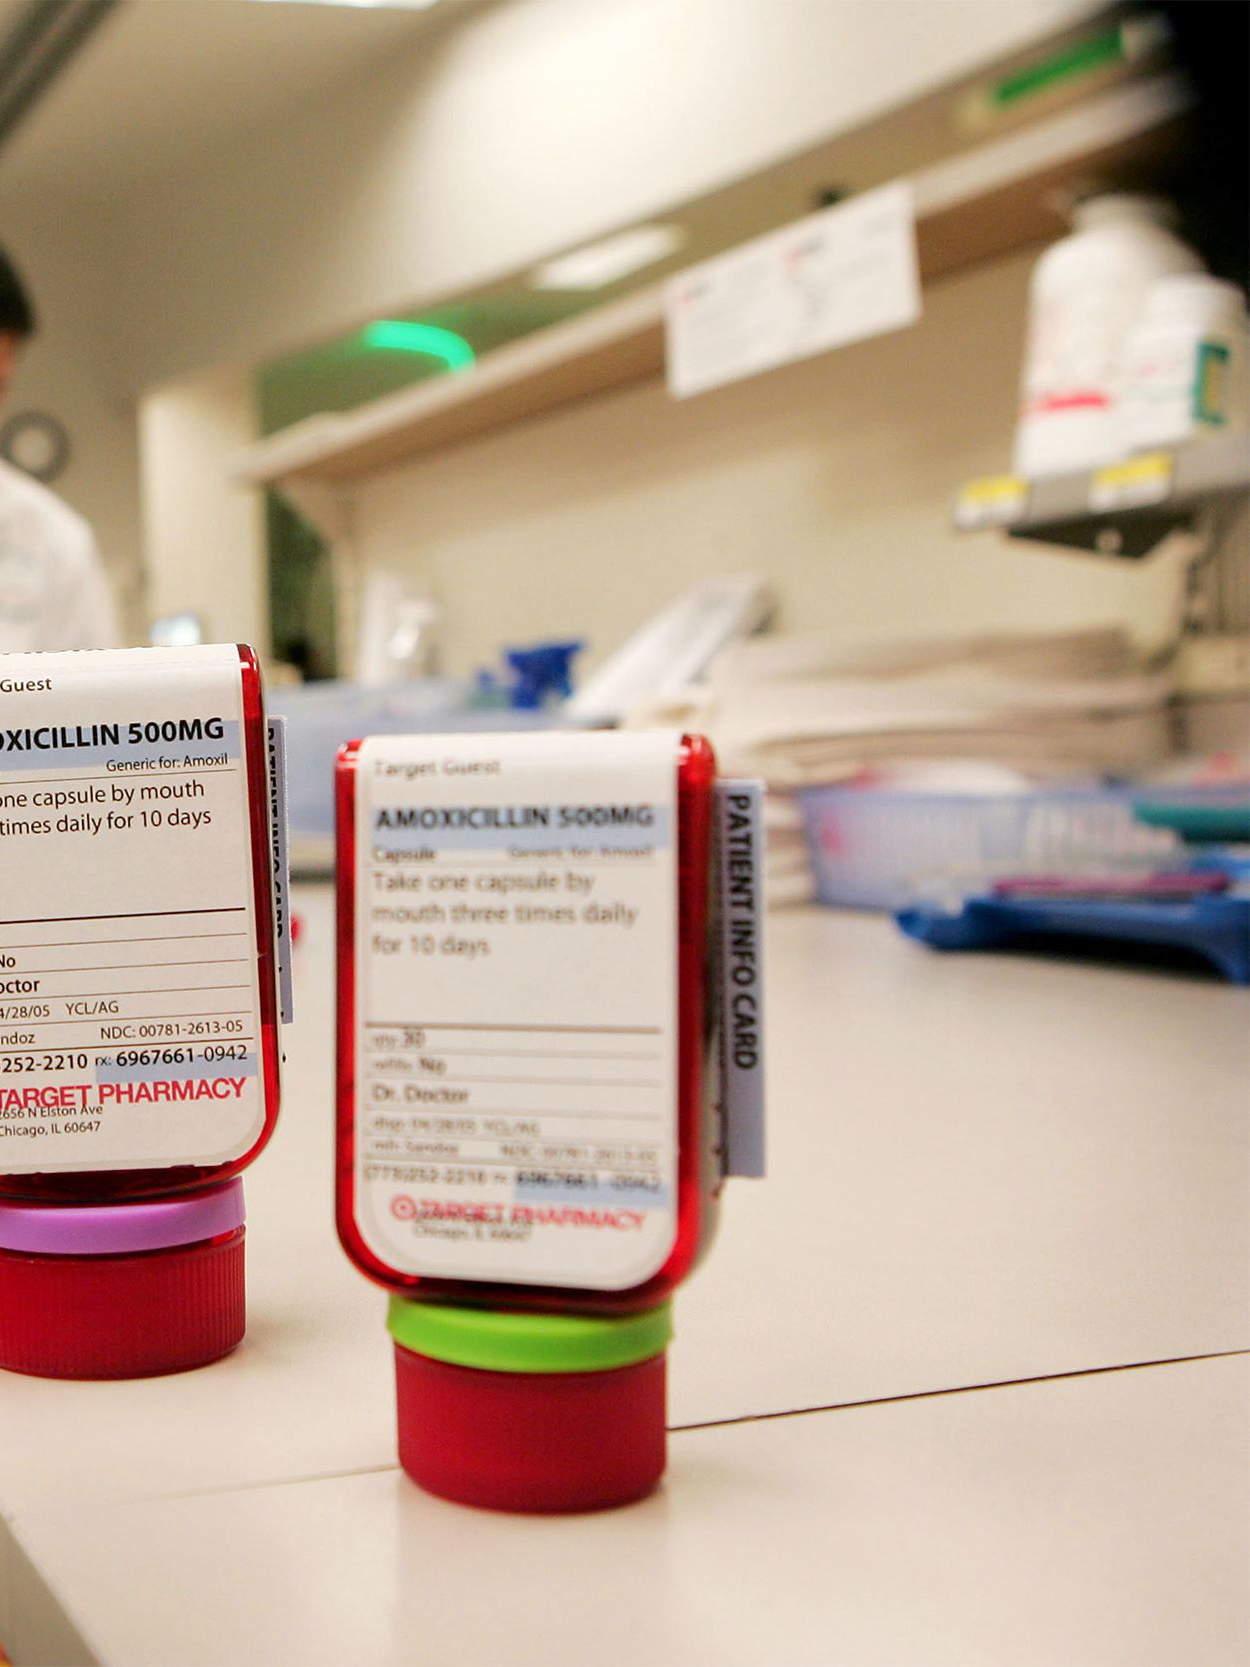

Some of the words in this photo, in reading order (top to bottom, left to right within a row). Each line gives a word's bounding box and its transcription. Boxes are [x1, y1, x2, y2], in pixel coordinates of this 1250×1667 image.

[0, 678, 52, 692] Guest
[128, 717, 224, 743] 500MG
[106, 757, 155, 772] Generic
[159, 756, 181, 768] for:
[183, 754, 228, 767] Amoxil
[375, 761, 436, 778] Target
[443, 760, 500, 774] Guest
[32, 786, 105, 810] capsule
[111, 784, 134, 805] by
[140, 780, 205, 799] mouth
[0, 819, 51, 835] times
[57, 814, 102, 838] daily
[107, 812, 133, 829] for
[141, 811, 162, 827] 10
[167, 808, 211, 830] days
[376, 808, 548, 830] AMOXICILLIN
[560, 805, 653, 826] 500MG
[728, 794, 754, 914] PATIENT
[375, 873, 420, 890] Take
[430, 874, 468, 891] one
[477, 872, 557, 895] capsule
[566, 871, 594, 895] by
[372, 904, 444, 922] mouth
[452, 902, 507, 923] three
[515, 904, 575, 923] times
[584, 902, 637, 926] daily
[372, 935, 402, 954] for
[411, 936, 433, 954] 10
[442, 936, 489, 959] days
[733, 924, 756, 988] INFO
[65, 1000, 119, 1016] YCL/AG
[100, 1026, 136, 1039] NDC:
[139, 1019, 243, 1038] 00781-2613-05
[735, 996, 757, 1071] CARD
[95, 1056, 112, 1065] rx:
[116, 1045, 248, 1067] 6967661-0942
[99, 1077, 247, 1104] PHARMACY
[406, 1086, 469, 1103] Doctor
[28, 1106, 37, 1117] N
[40, 1104, 77, 1117] Elston
[80, 1103, 103, 1115] Ave
[51, 1123, 61, 1134] IL
[64, 1121, 101, 1133] 60647
[513, 1204, 647, 1231] PHARMACY
